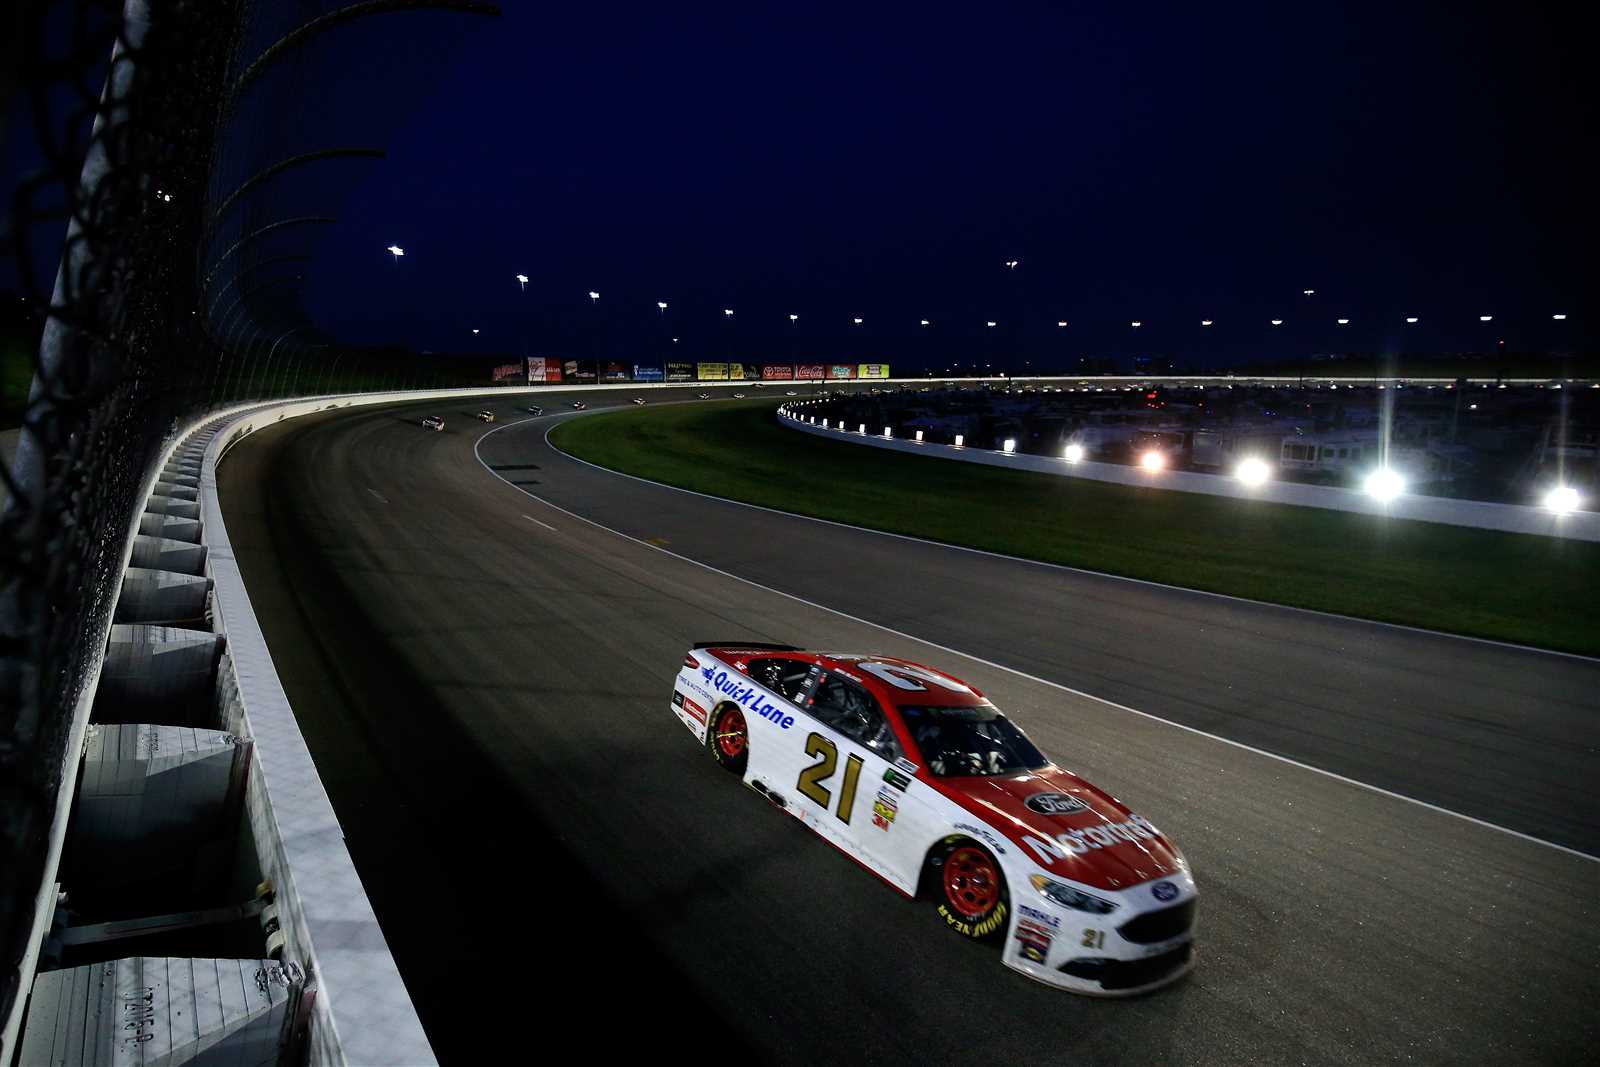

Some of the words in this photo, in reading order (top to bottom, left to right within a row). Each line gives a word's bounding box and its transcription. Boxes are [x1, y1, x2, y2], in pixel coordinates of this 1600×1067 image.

[714, 671, 754, 706] Quick
[749, 694, 796, 730] Lane
[796, 731, 866, 827] 21
[1037, 795, 1084, 812] Ford
[1081, 927, 1105, 950] 21
